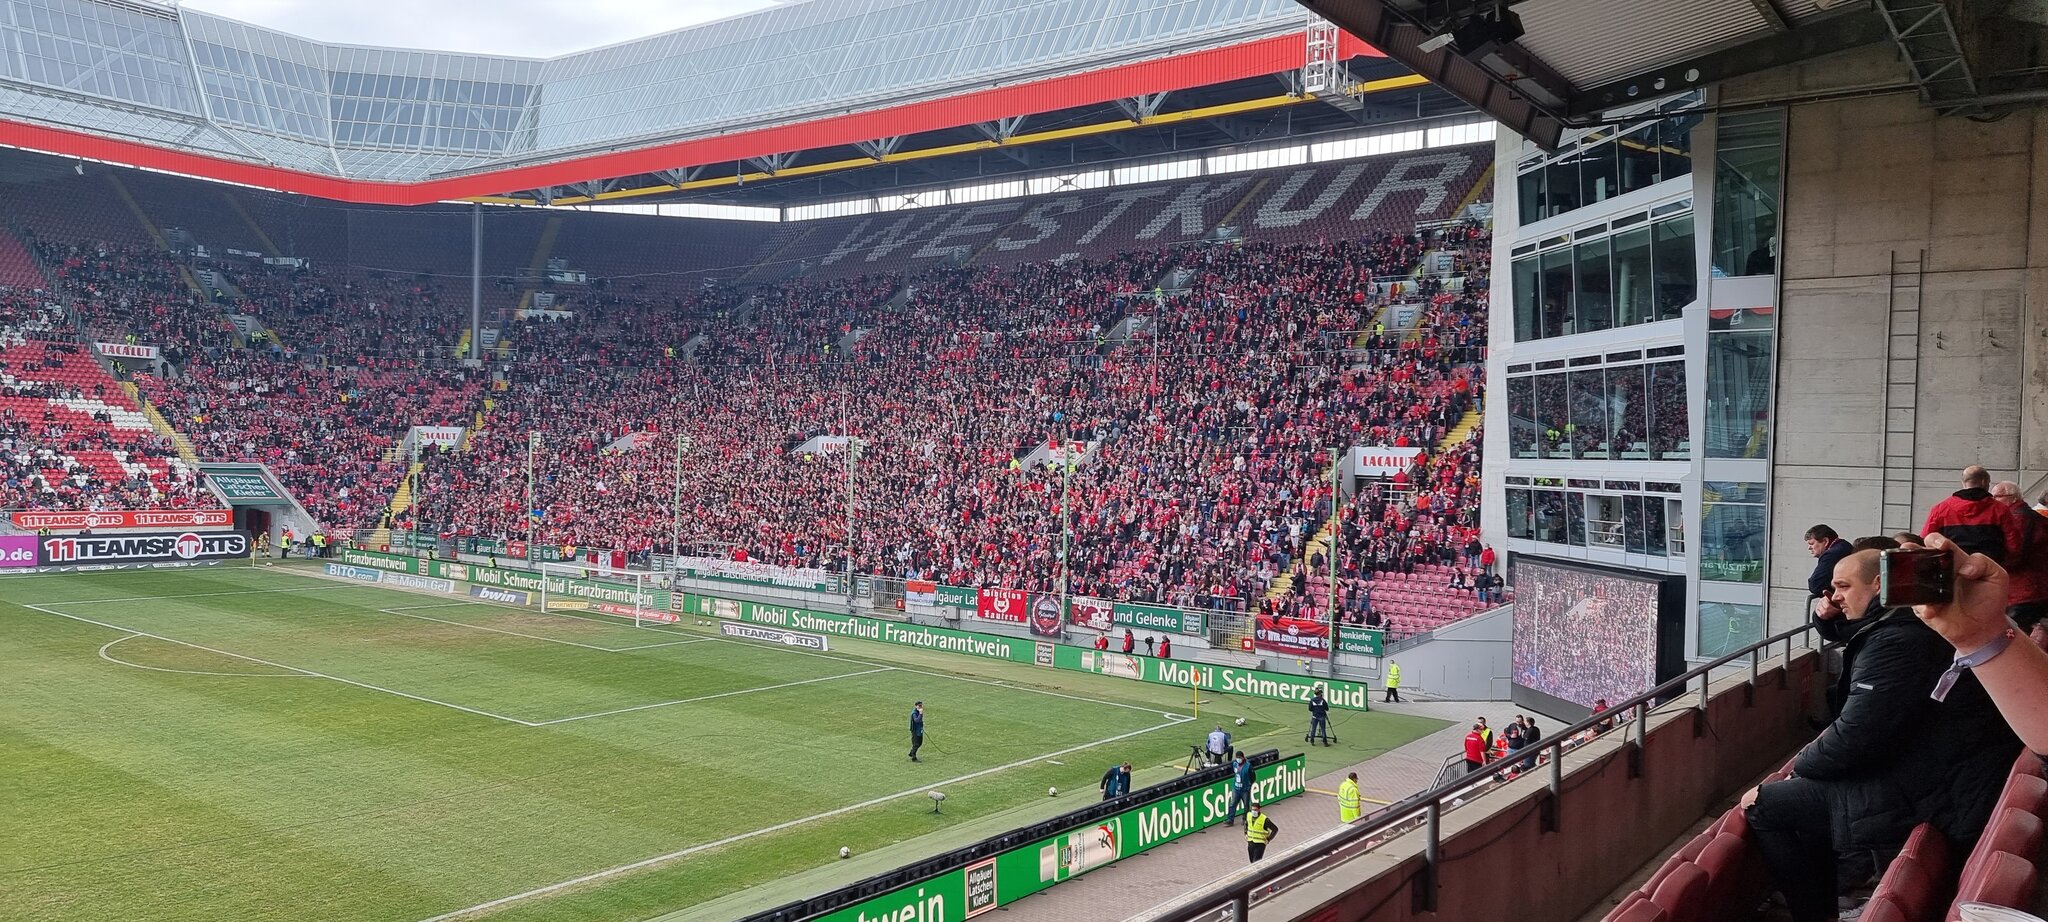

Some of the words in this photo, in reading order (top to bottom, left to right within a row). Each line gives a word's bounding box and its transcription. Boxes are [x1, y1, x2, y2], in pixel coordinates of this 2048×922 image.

[101, 344, 151, 357] LACALUT
[425, 432, 457, 440] ACALUT
[1363, 455, 1414, 467] LACALUT
[216, 476, 261, 485] Allgäuer
[44, 533, 246, 562] 11TEAMSPORTS
[344, 551, 407, 571] Franzbranntwein
[399, 576, 427, 589] Mobil
[430, 581, 447, 592] Gel
[475, 567, 501, 584] Mobil
[503, 571, 565, 591] Schmerzfluid
[568, 580, 653, 606] Franzbranntwein
[479, 587, 516, 603] bwin
[936, 590, 963, 605] lgäuer
[1113, 610, 1133, 624] und
[1136, 611, 1177, 628] Gelenke
[752, 604, 787, 626] Mobil
[792, 610, 879, 639] Schmerzfluid
[885, 623, 1010, 658] Franzbranntwein
[1339, 628, 1372, 642] henkiefer
[1243, 640, 1251, 648] 10
[1345, 642, 1374, 654] Gelenke
[1158, 661, 1213, 688] Mobil
[1138, 795, 1195, 847] Mobil
[1202, 760, 1306, 823] Scherzflui
[969, 868, 993, 885] Allgäuer
[969, 880, 993, 897] Latschen
[972, 892, 990, 908] Kiefer
